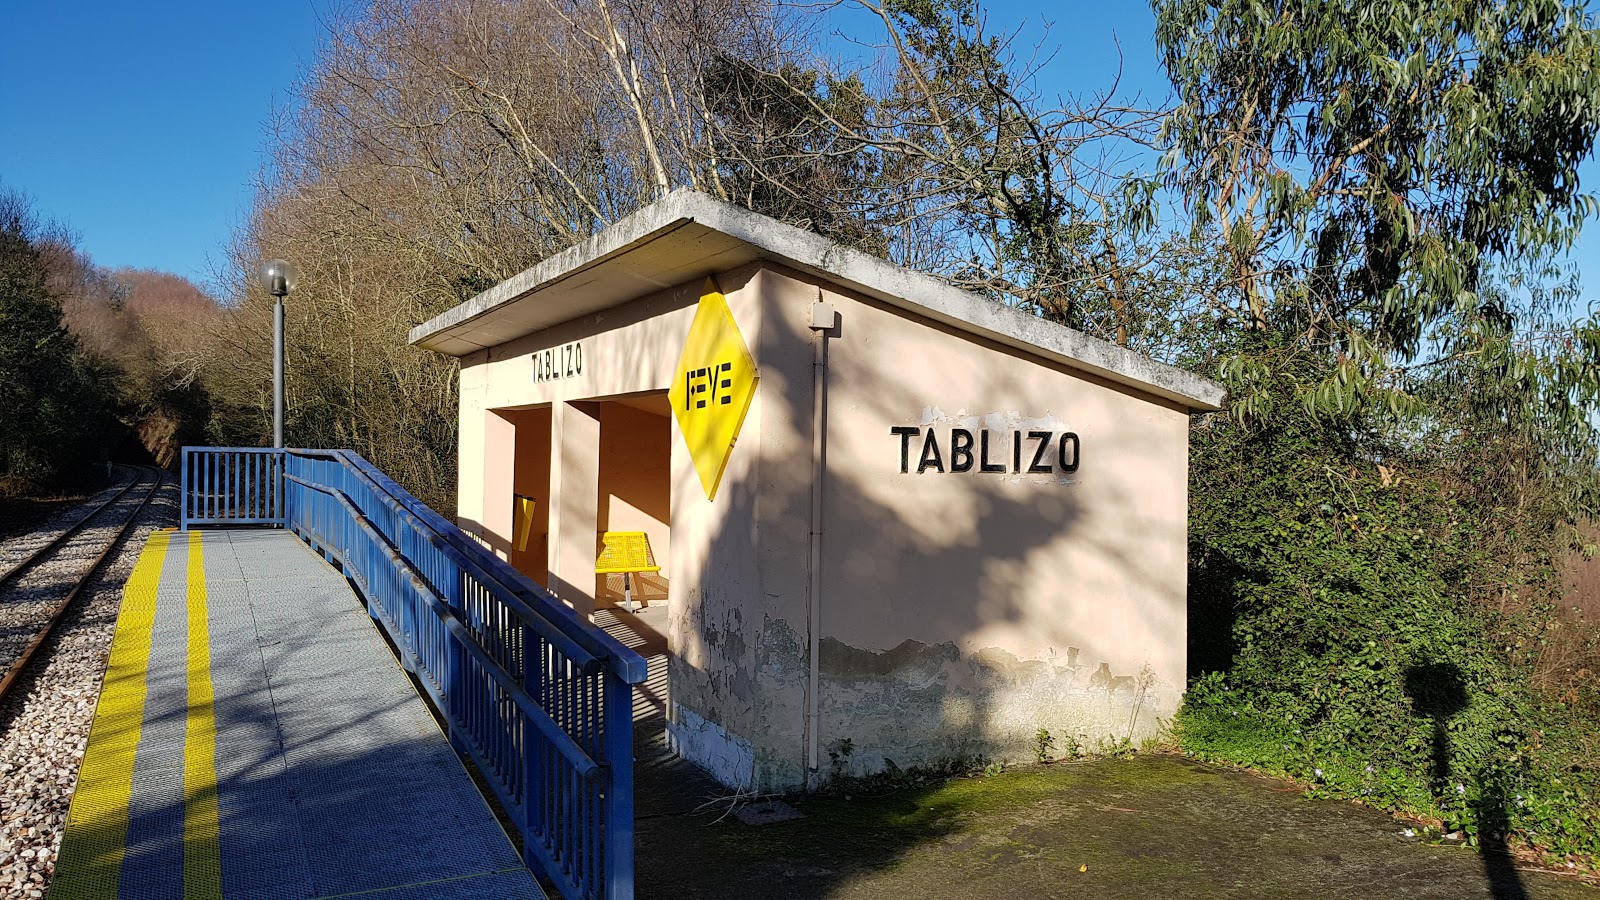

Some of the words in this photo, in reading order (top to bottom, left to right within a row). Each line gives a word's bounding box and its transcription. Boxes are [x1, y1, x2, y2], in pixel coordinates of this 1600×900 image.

[531, 342, 583, 383] TABLIZO
[686, 362, 732, 411] FEVE
[890, 426, 1081, 474] TABLIZO
